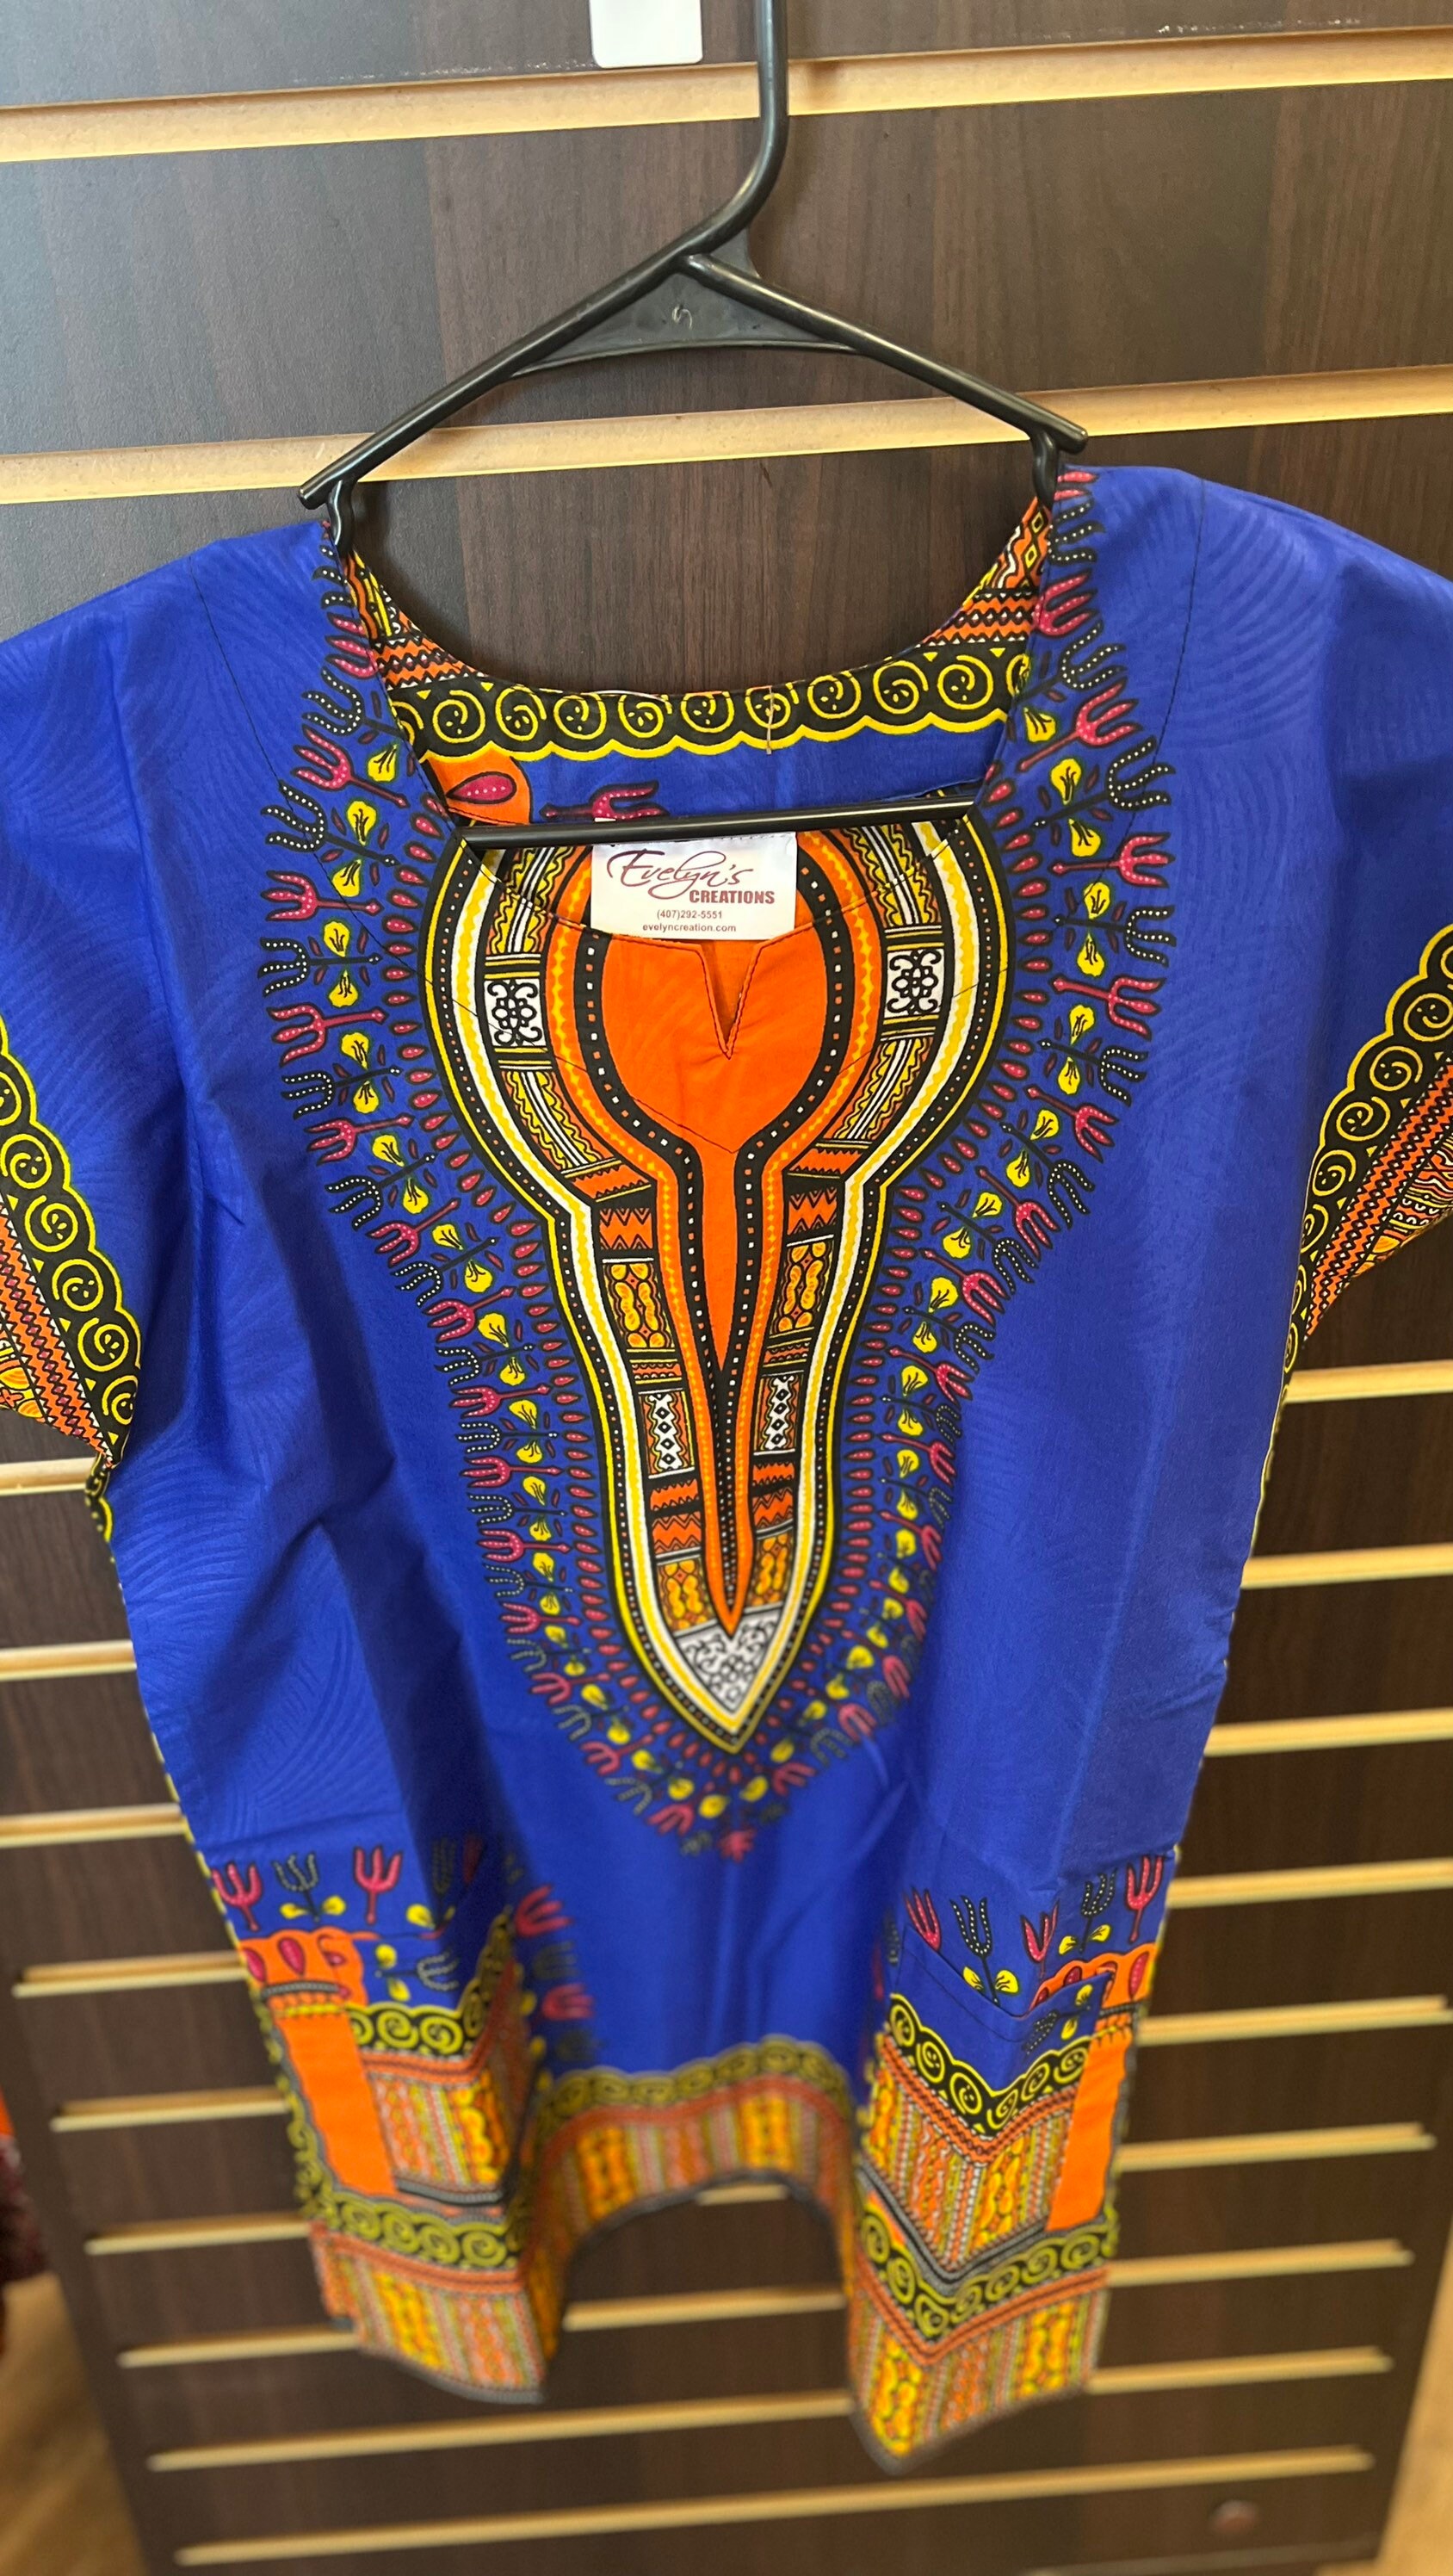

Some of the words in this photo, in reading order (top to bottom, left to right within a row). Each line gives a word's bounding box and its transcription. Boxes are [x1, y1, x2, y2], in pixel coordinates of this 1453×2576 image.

[607, 849, 754, 900] Evelyn's
[689, 889, 776, 904] CREATIONS
[656, 909, 723, 920] (407)292-5551
[642, 923, 737, 933] evelyncreation.com
